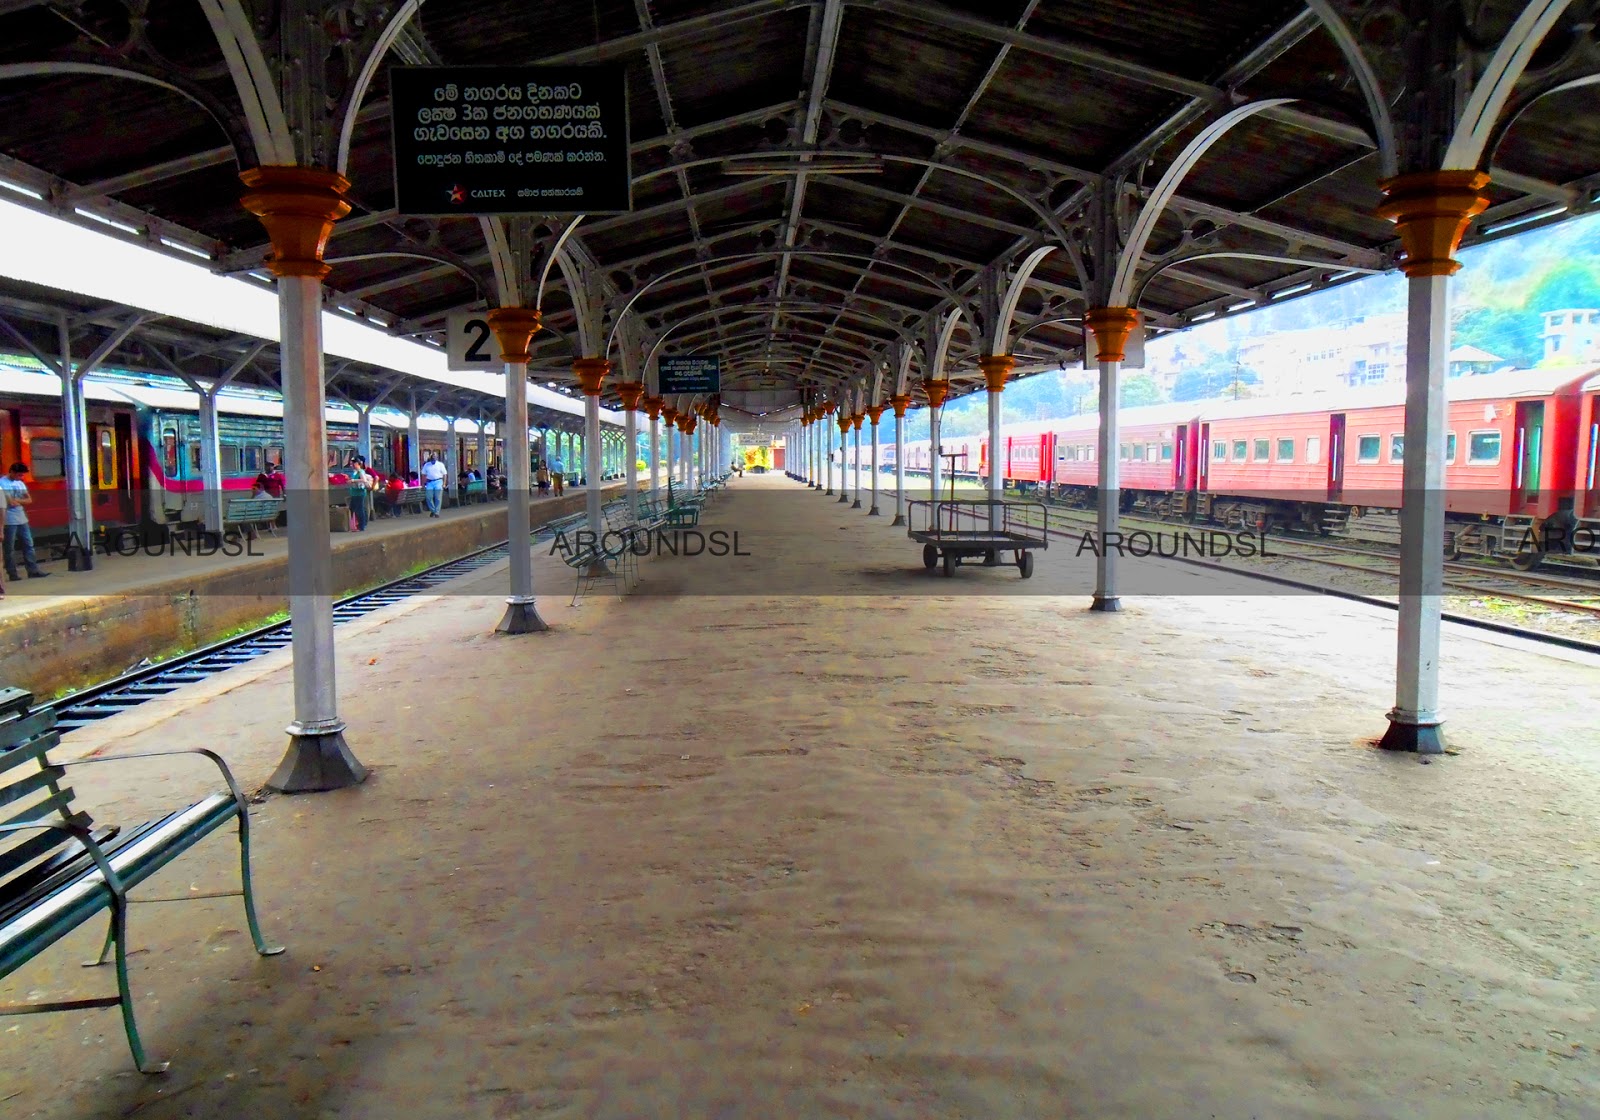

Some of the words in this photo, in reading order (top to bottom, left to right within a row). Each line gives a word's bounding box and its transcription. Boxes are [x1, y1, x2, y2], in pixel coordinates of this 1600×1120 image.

[434, 83, 459, 102] මේ
[463, 84, 522, 102] නගරය
[526, 82, 582, 104] දිනකට
[462, 104, 488, 121] 3ක
[413, 124, 490, 142] ගැවසෙන
[495, 124, 525, 143] අග
[470, 189, 506, 199] CALTEX
[464, 319, 491, 362] 2
